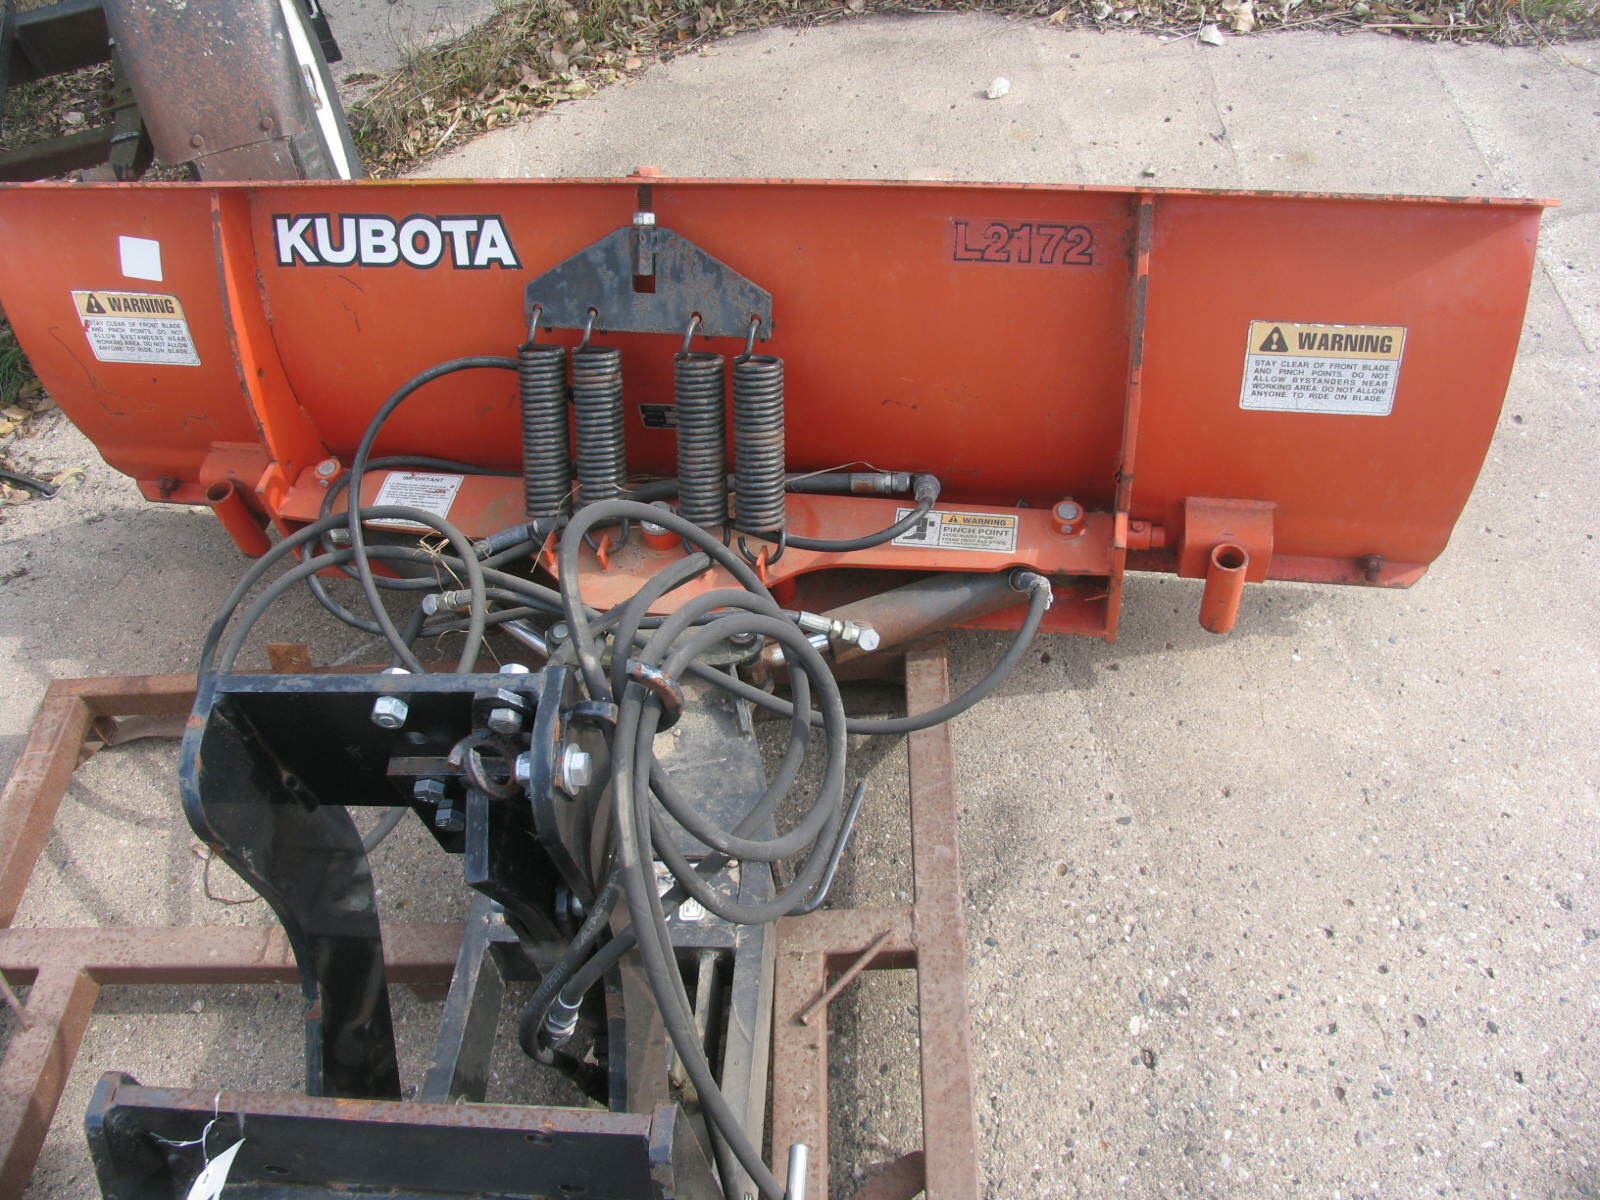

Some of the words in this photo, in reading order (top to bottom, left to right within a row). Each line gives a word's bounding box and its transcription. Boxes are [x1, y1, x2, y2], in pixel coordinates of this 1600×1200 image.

[272, 213, 522, 269] KUBOTA
[953, 222, 1095, 265] L2172
[107, 297, 175, 314] WARNING
[1298, 332, 1393, 354] WARNING
[1254, 360, 1277, 368] STAY
[1280, 361, 1309, 369] CLEAR
[1329, 363, 1358, 371] FRONT
[1362, 364, 1391, 372] BLADE
[1253, 367, 1272, 375] AND
[1279, 368, 1305, 376] PINCH
[1351, 371, 1365, 379] DO
[1371, 372, 1390, 380] NOT
[1252, 375, 1287, 383] ALLOW
[1292, 378, 1356, 386] BYSTANDERS
[1251, 383, 1292, 391] WORKING
[1336, 386, 1354, 394] NOT
[1356, 387, 1387, 395] ALLOW
[1250, 390, 1287, 398] ANYONE
[1334, 393, 1348, 401] ON
[402, 475, 445, 483] IMPORTANT
[963, 518, 1007, 526] WARNING
[978, 529, 1010, 537] POINT
